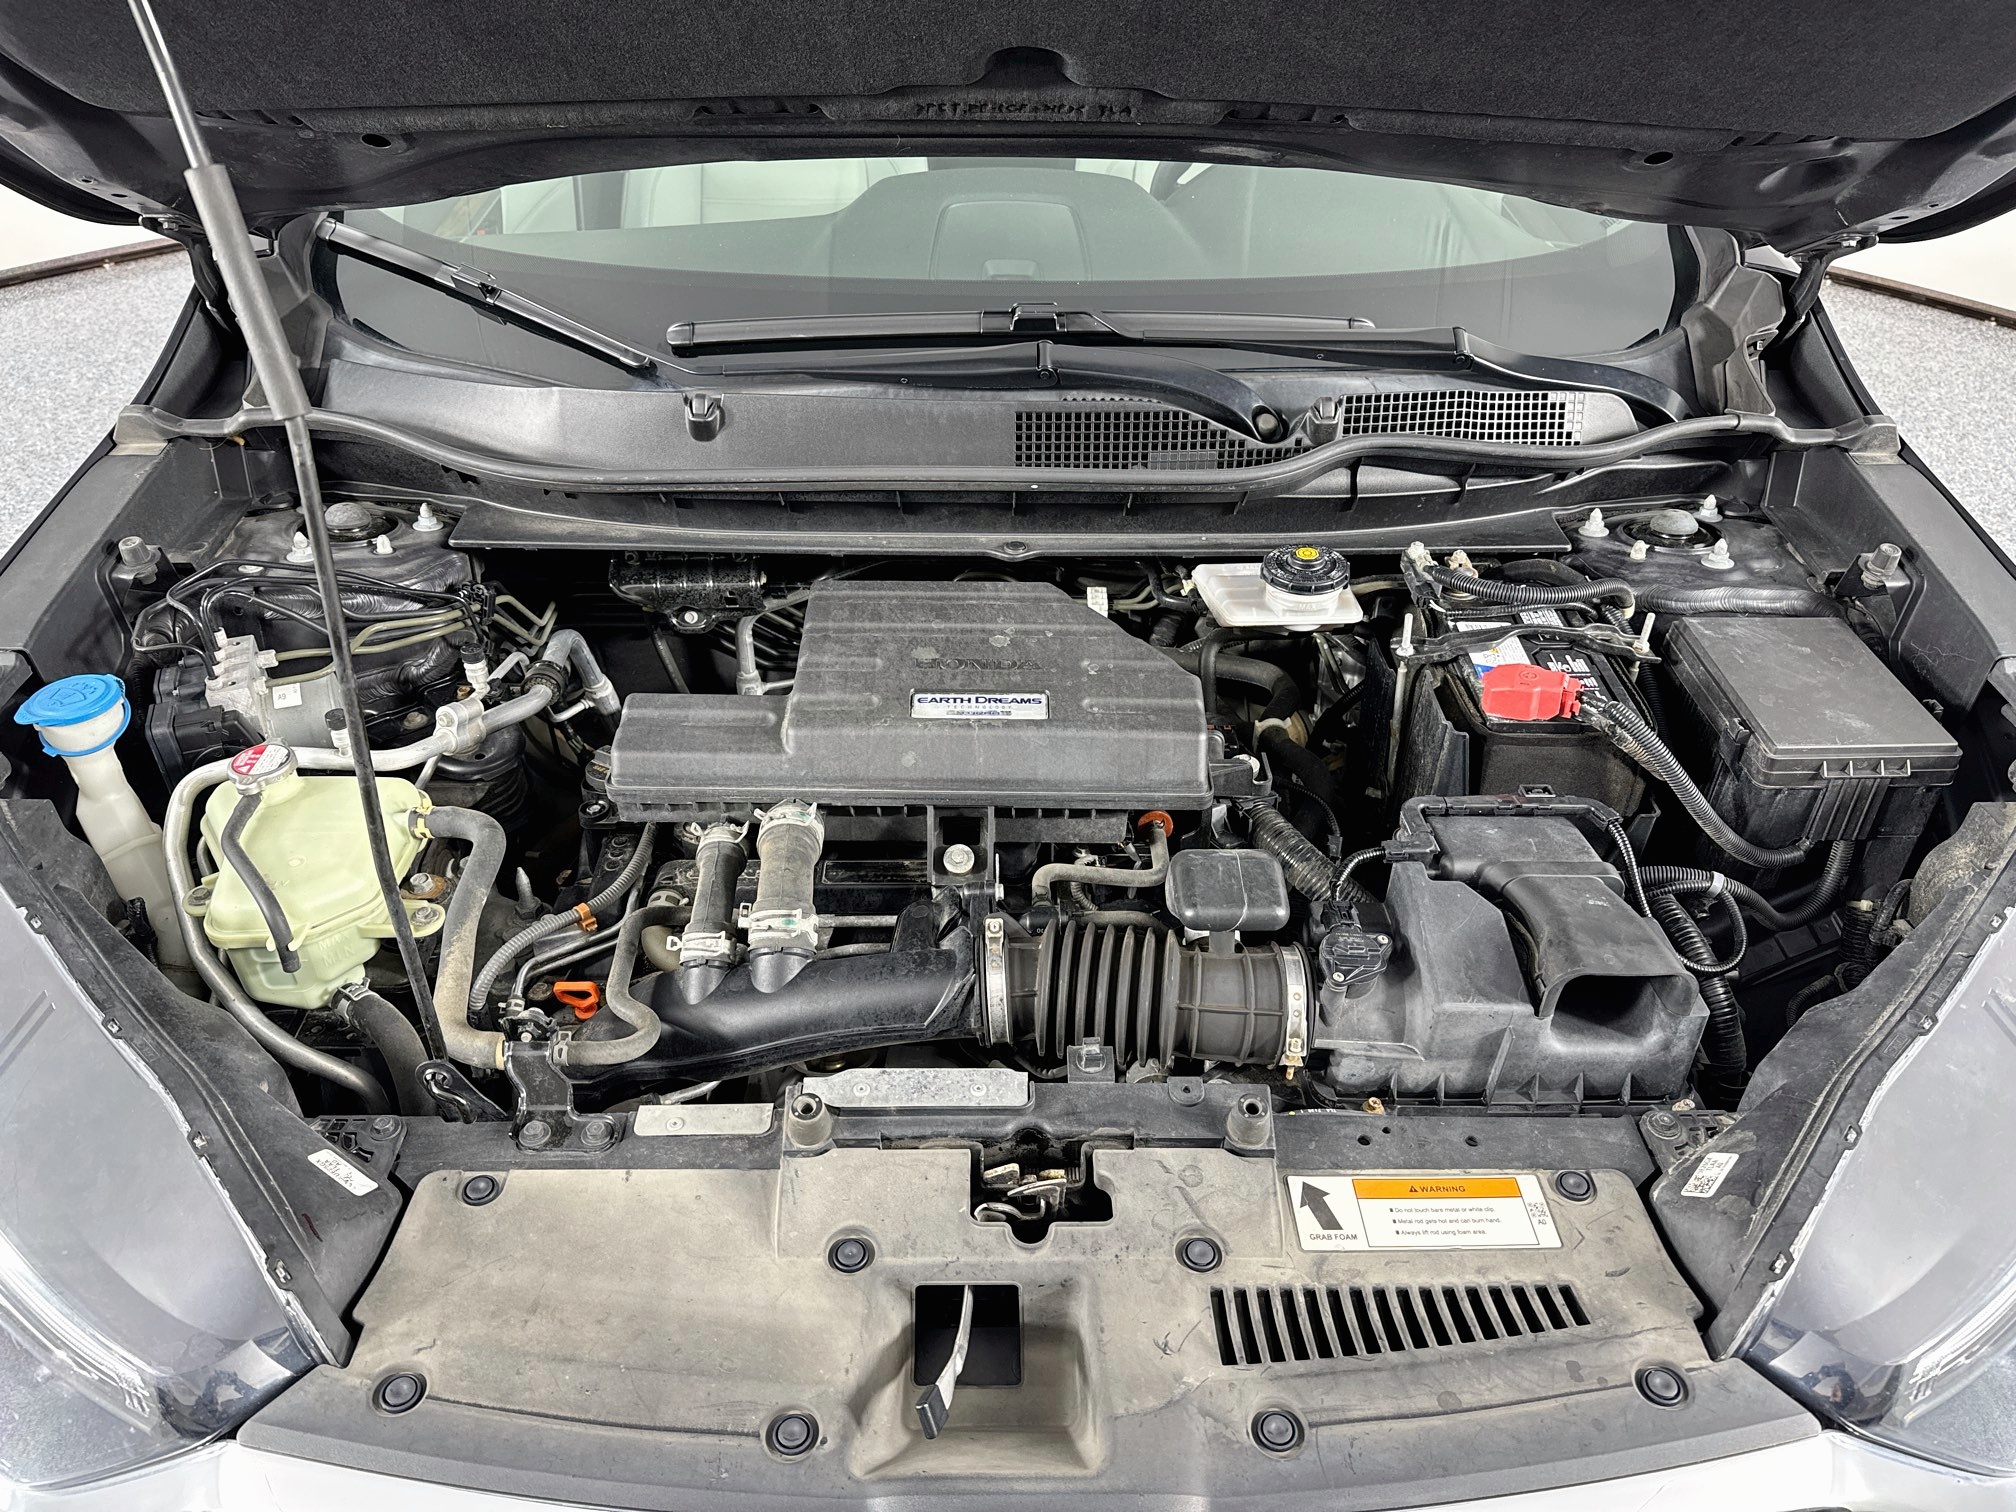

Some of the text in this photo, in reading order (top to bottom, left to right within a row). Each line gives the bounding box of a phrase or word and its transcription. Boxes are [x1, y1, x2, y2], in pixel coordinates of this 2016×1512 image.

[975, 696, 1042, 704] DREAMS
[1419, 1185, 1466, 1193] WARNING
[1309, 1233, 1358, 1241] GRAB FOAM
